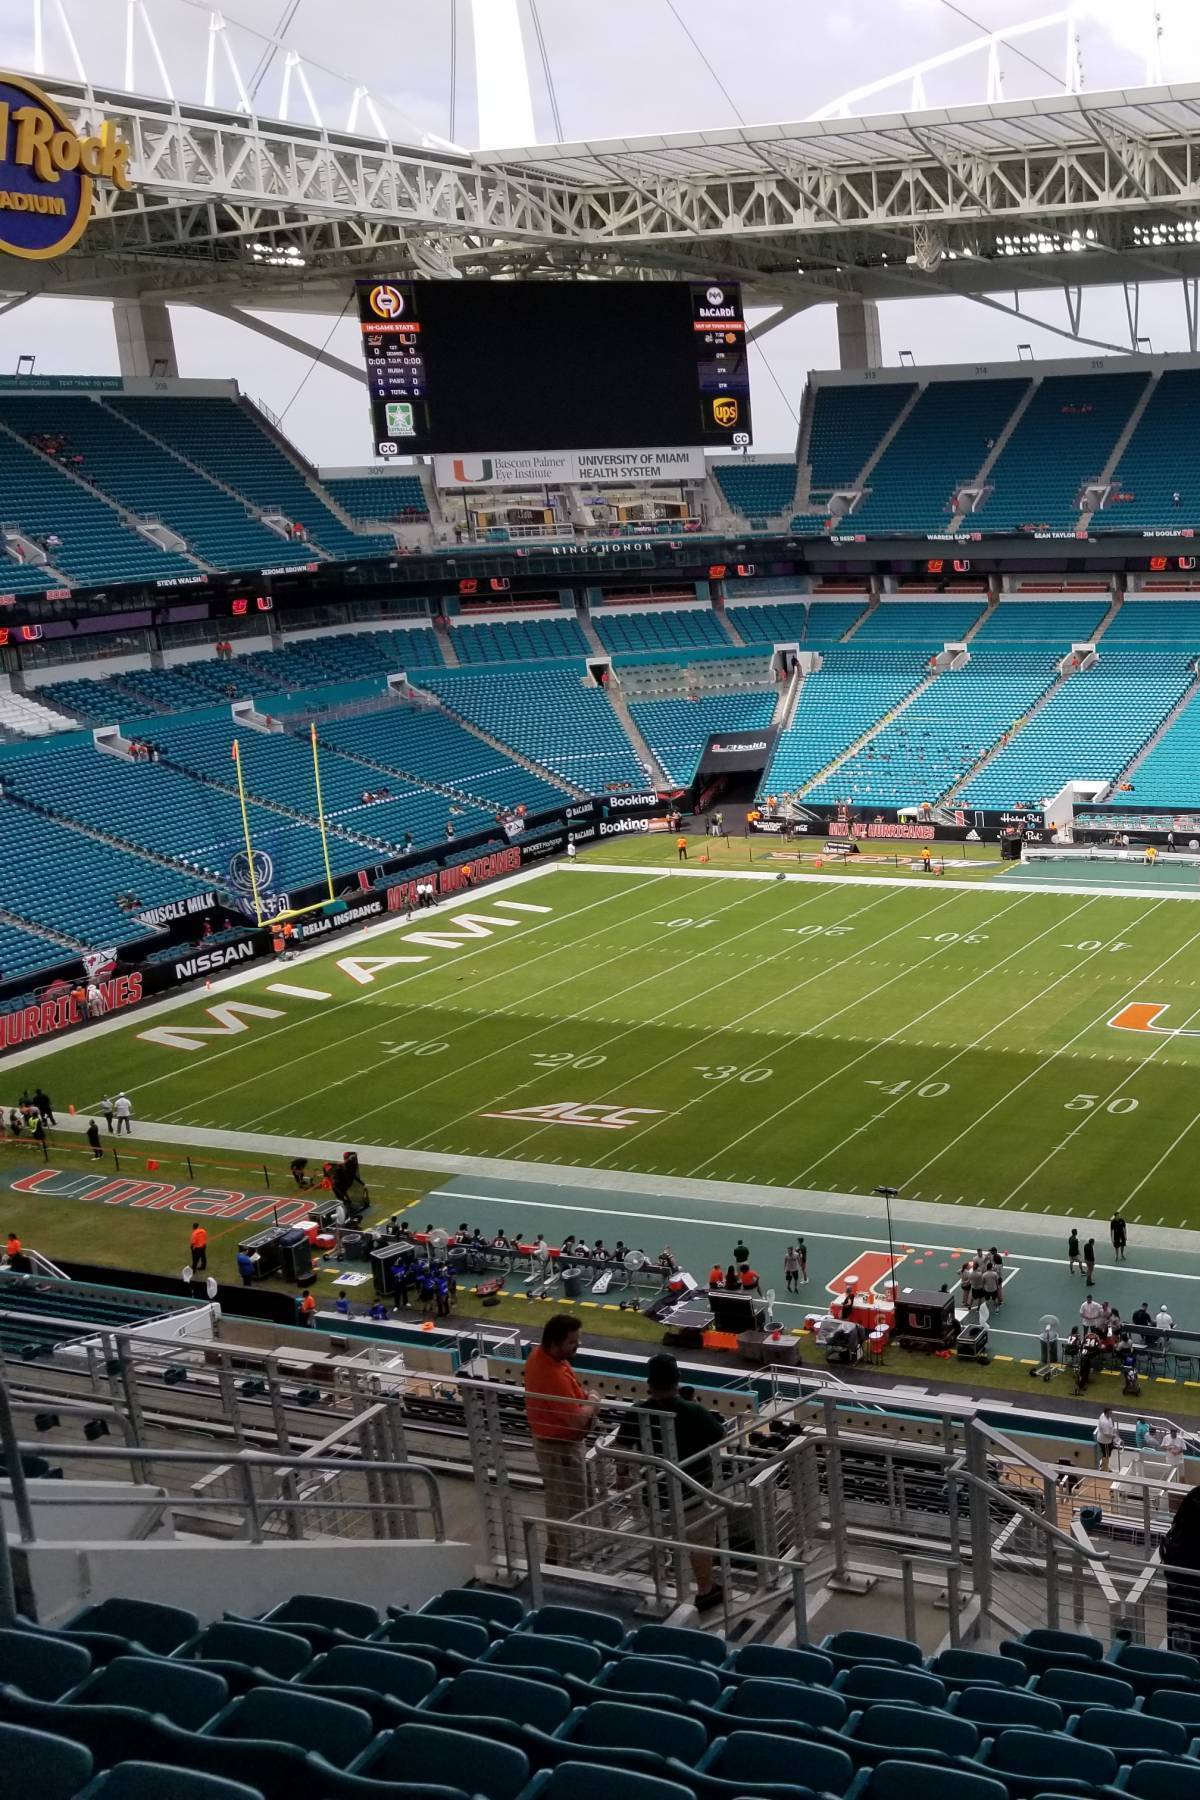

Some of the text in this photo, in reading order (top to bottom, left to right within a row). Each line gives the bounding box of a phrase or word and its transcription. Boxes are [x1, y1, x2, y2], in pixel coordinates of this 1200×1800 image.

[12, 106, 133, 191] Rock
[0, 192, 66, 216] ADIUM
[700, 306, 735, 317] BACARDÍ
[716, 406, 736, 422] ups
[734, 435, 748, 443] CC
[380, 445, 396, 453] CC
[494, 457, 565, 469] Bascom Palmer
[578, 452, 690, 466] UNIVERSITY OF MIAMI
[368, 466, 384, 475] 309
[453, 459, 492, 483] U
[495, 467, 553, 480] Eye Institute
[579, 466, 661, 479] HEALTH SYSTEM
[552, 543, 652, 555] RING HONOR
[261, 568, 285, 576] JEROME
[286, 565, 307, 574] BROWN
[156, 577, 202, 587] STEVE WALSH
[572, 801, 594, 816] BACARDÍ
[600, 818, 649, 835] Booking
[868, 823, 935, 840] HURRICANES
[140, 903, 186, 925] MUSCLE
[187, 892, 216, 913] MILK
[291, 919, 332, 939] TRELLA
[666, 916, 721, 929] 10
[797, 925, 856, 937] 20
[932, 931, 991, 944] 30
[1075, 940, 1135, 952] 40
[175, 941, 254, 980] NISSAN
[136, 900, 553, 1051] MIAMI
[0, 971, 143, 1050] URRICNES
[390, 1040, 451, 1057] 10
[536, 1052, 608, 1070] 20
[704, 1065, 774, 1084] 30
[878, 1080, 951, 1099] 40
[1063, 1094, 1139, 1114] 50
[492, 1101, 667, 1129] ACC
[908, 1312, 931, 1330] U
[1085, 1338, 1095, 1347] 34
